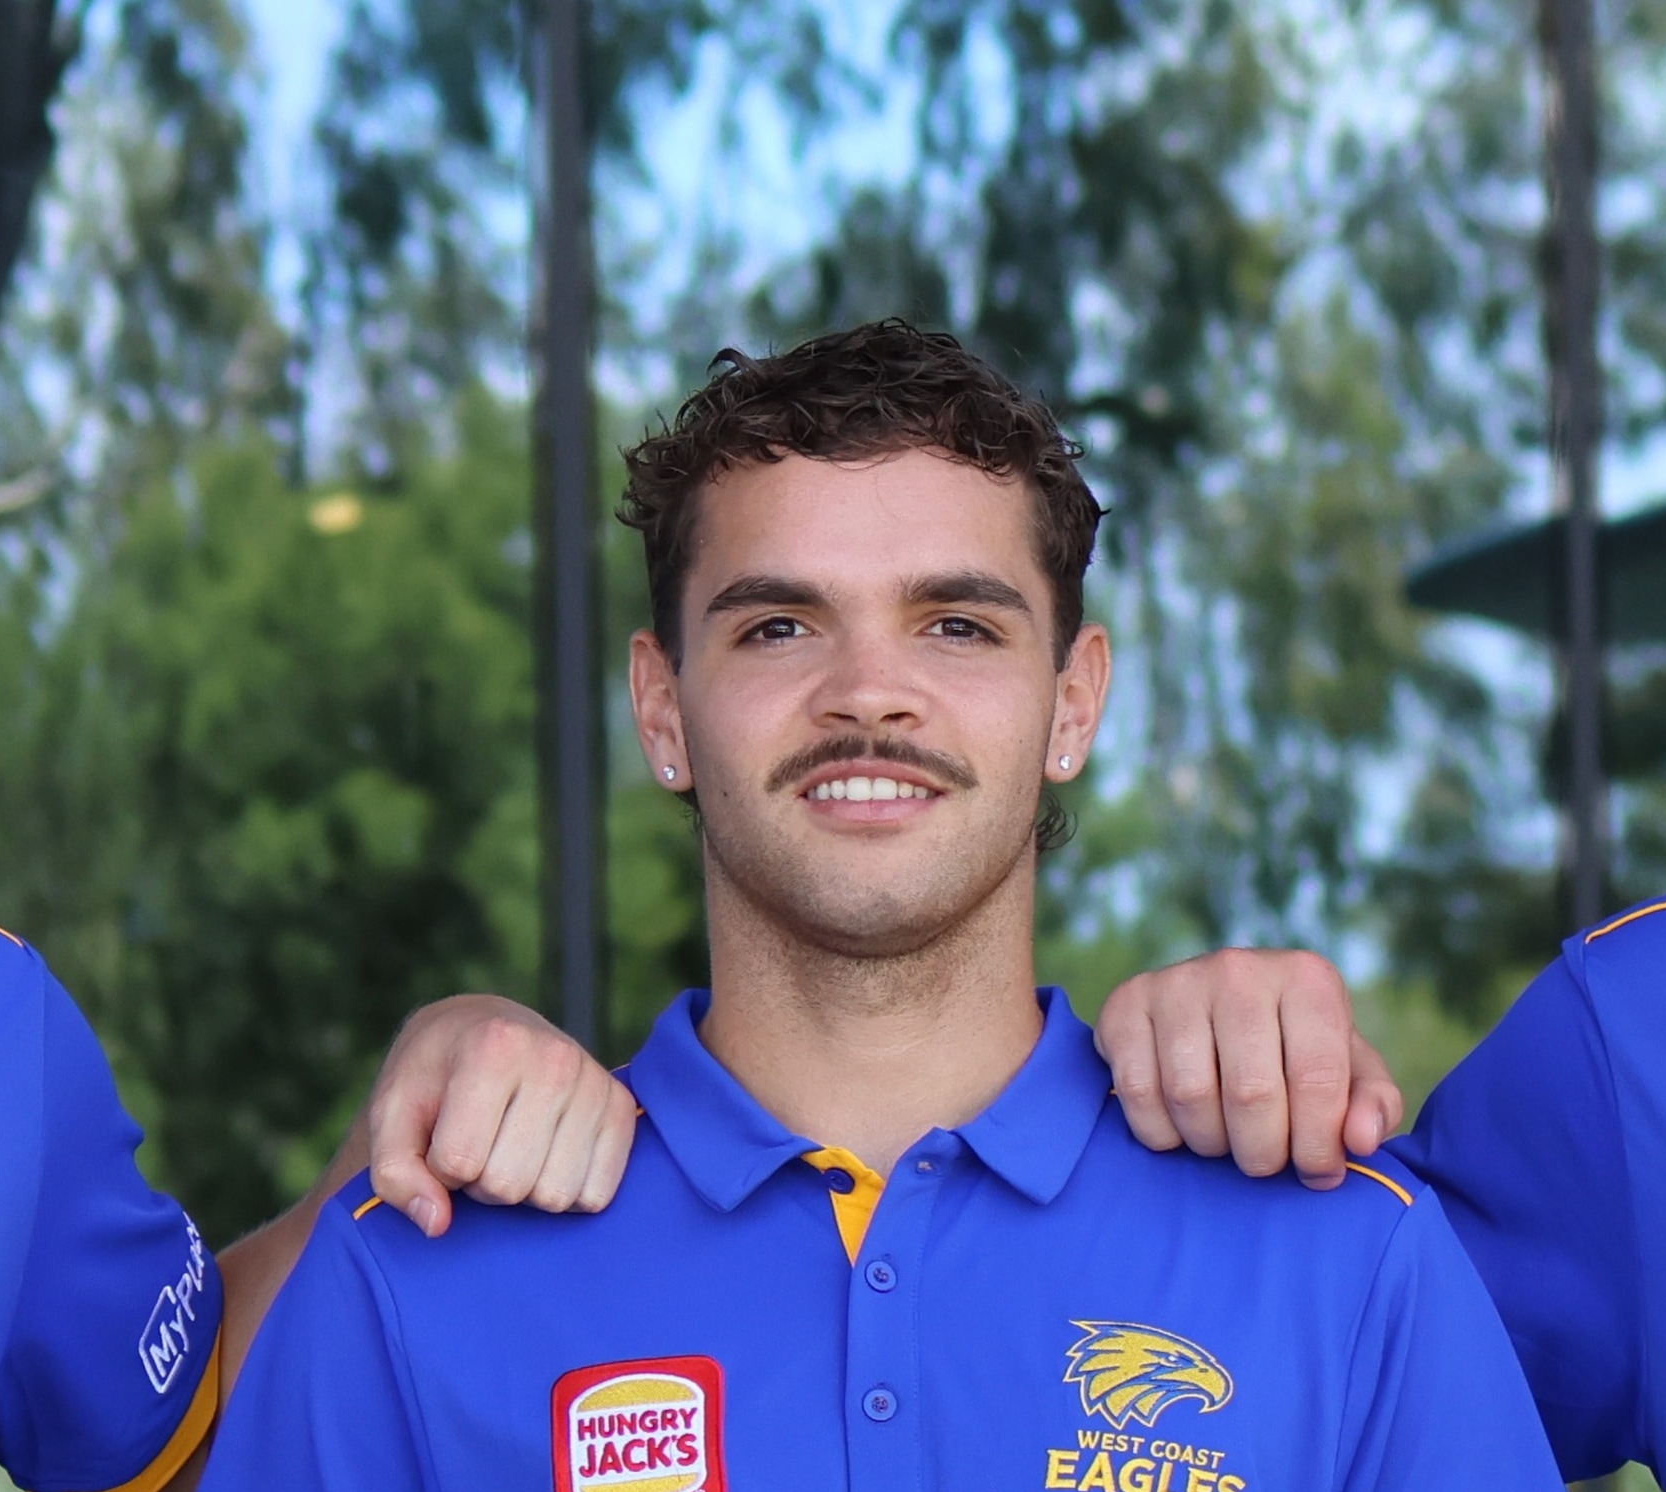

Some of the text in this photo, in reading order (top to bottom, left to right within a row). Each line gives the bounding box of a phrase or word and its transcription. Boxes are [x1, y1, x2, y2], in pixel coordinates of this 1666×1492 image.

[577, 1407, 698, 1441] HUNGRY
[579, 1433, 699, 1478] JACK'S
[1077, 1430, 1225, 1469] WEST COAST
